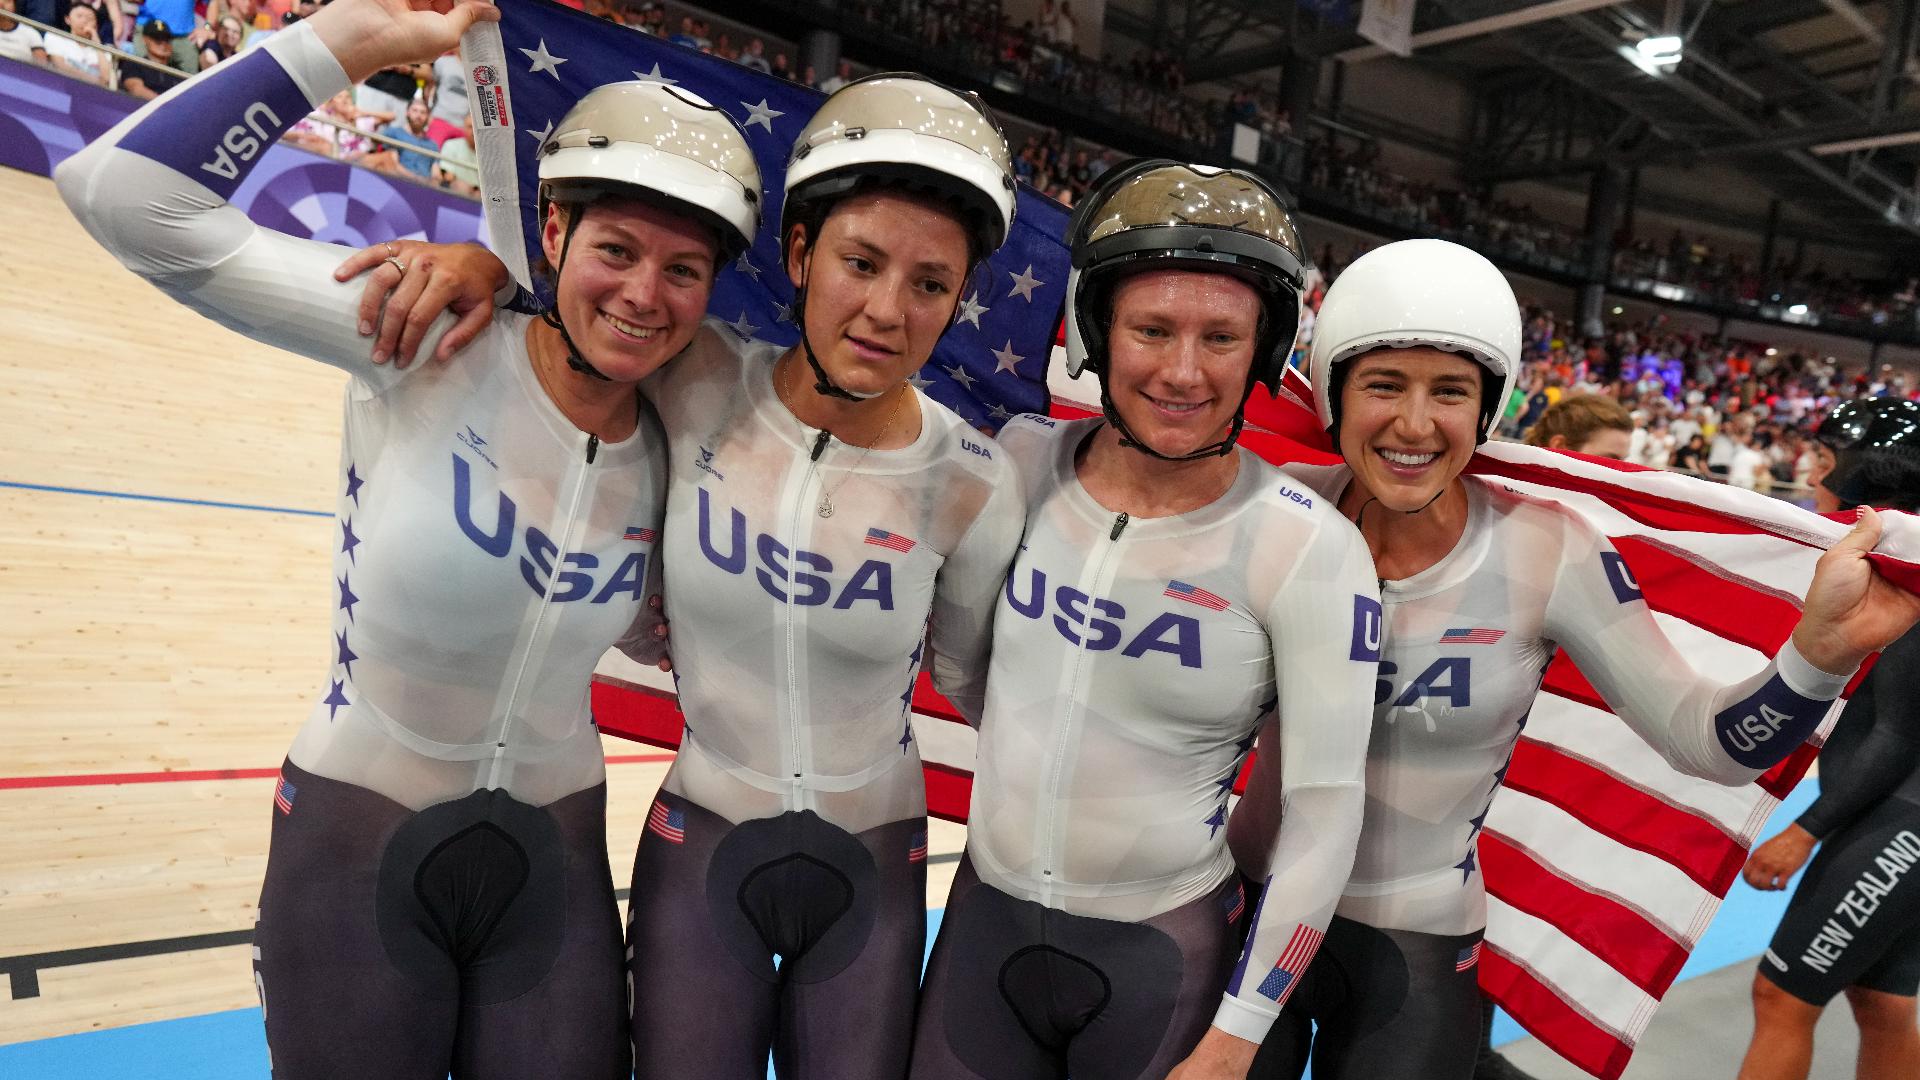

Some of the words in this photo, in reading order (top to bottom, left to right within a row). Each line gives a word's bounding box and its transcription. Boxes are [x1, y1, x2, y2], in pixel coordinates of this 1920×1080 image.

[200, 101, 282, 180] USA
[1023, 414, 1057, 429] USA
[456, 431, 499, 471] CUORE
[695, 459, 724, 482] CUORE
[961, 438, 993, 461] USA
[1279, 486, 1313, 510] USA
[452, 452, 647, 604] USA
[698, 487, 894, 612] USA
[1006, 562, 1203, 669] USA
[1725, 703, 1795, 753] USA
[1801, 918, 1855, 974] NEW
[1834, 830, 1920, 929] ZEALAND
